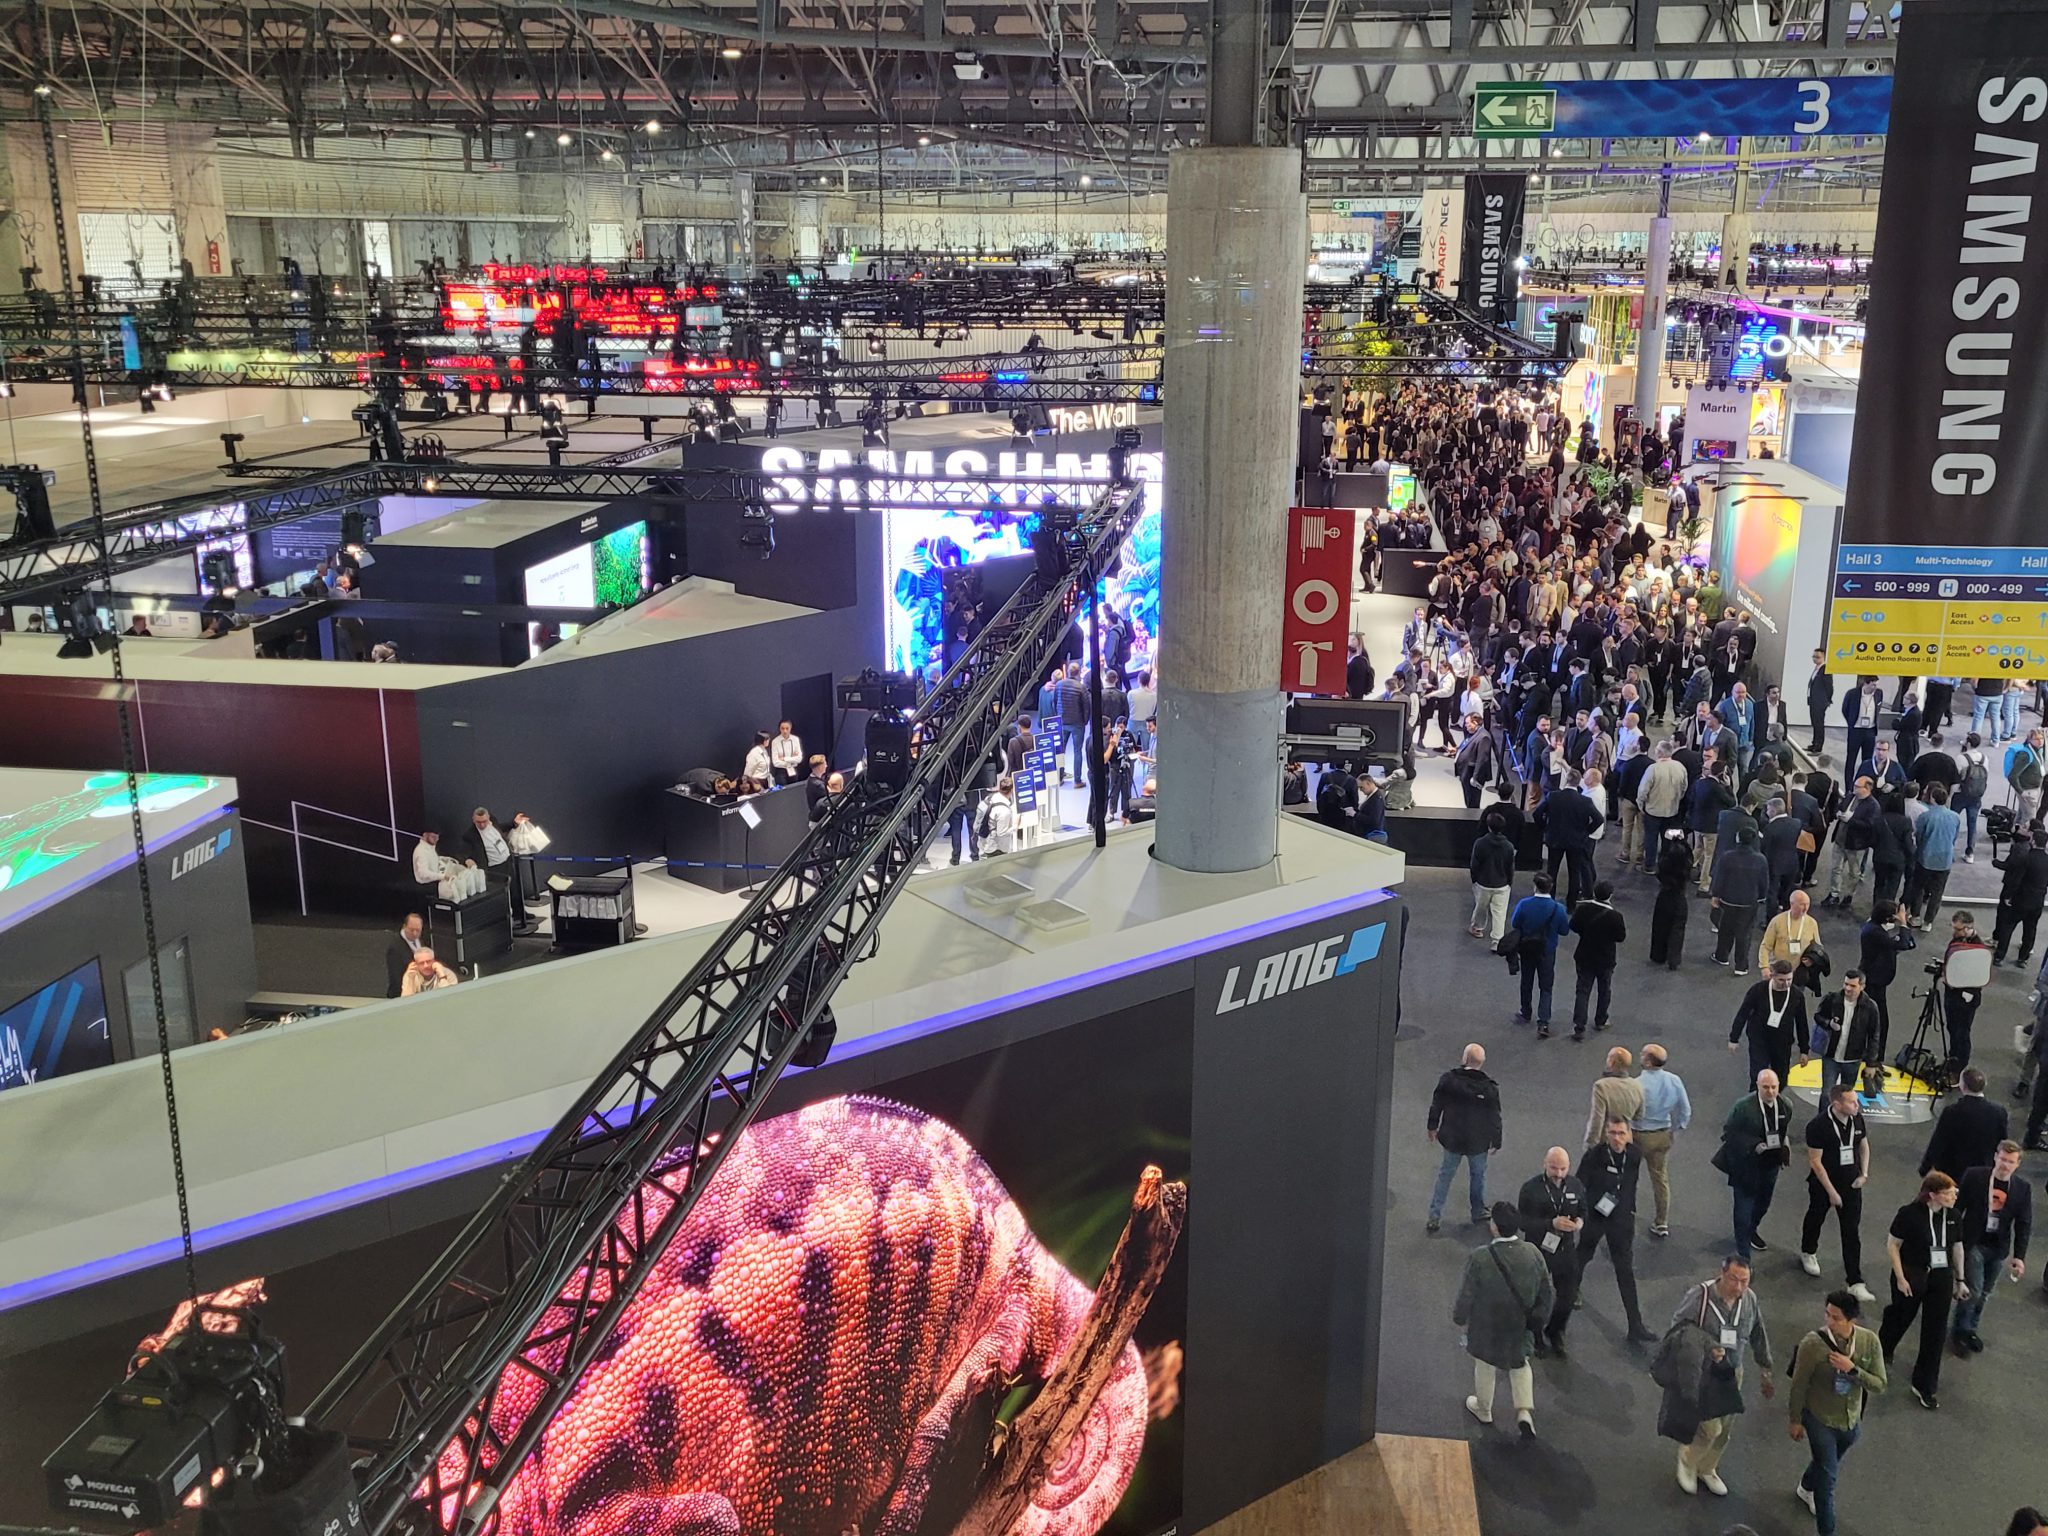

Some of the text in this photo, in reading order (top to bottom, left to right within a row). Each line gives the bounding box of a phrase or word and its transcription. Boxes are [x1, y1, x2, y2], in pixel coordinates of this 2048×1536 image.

[1793, 80, 1831, 134] 3
[1478, 194, 1504, 308] SAMSUNG
[1930, 76, 2048, 495] SAMSUNG
[1740, 334, 1855, 357] SONY
[1700, 401, 1737, 413] Martin
[1049, 402, 1137, 434] The Wall
[1845, 553, 1882, 565] Hall 3
[1915, 556, 1993, 567] Multi-Technology
[2021, 556, 2047, 568] Hall
[1874, 581, 1897, 592] 500
[1907, 582, 1930, 593] 999
[1966, 583, 1990, 594] 000
[1999, 584, 2023, 594] 499
[171, 836, 217, 881] LANG
[1215, 934, 1345, 1016] LANG
[86, 1480, 137, 1495] MOVECAT
[69, 1498, 118, 1513] MOVECAT
